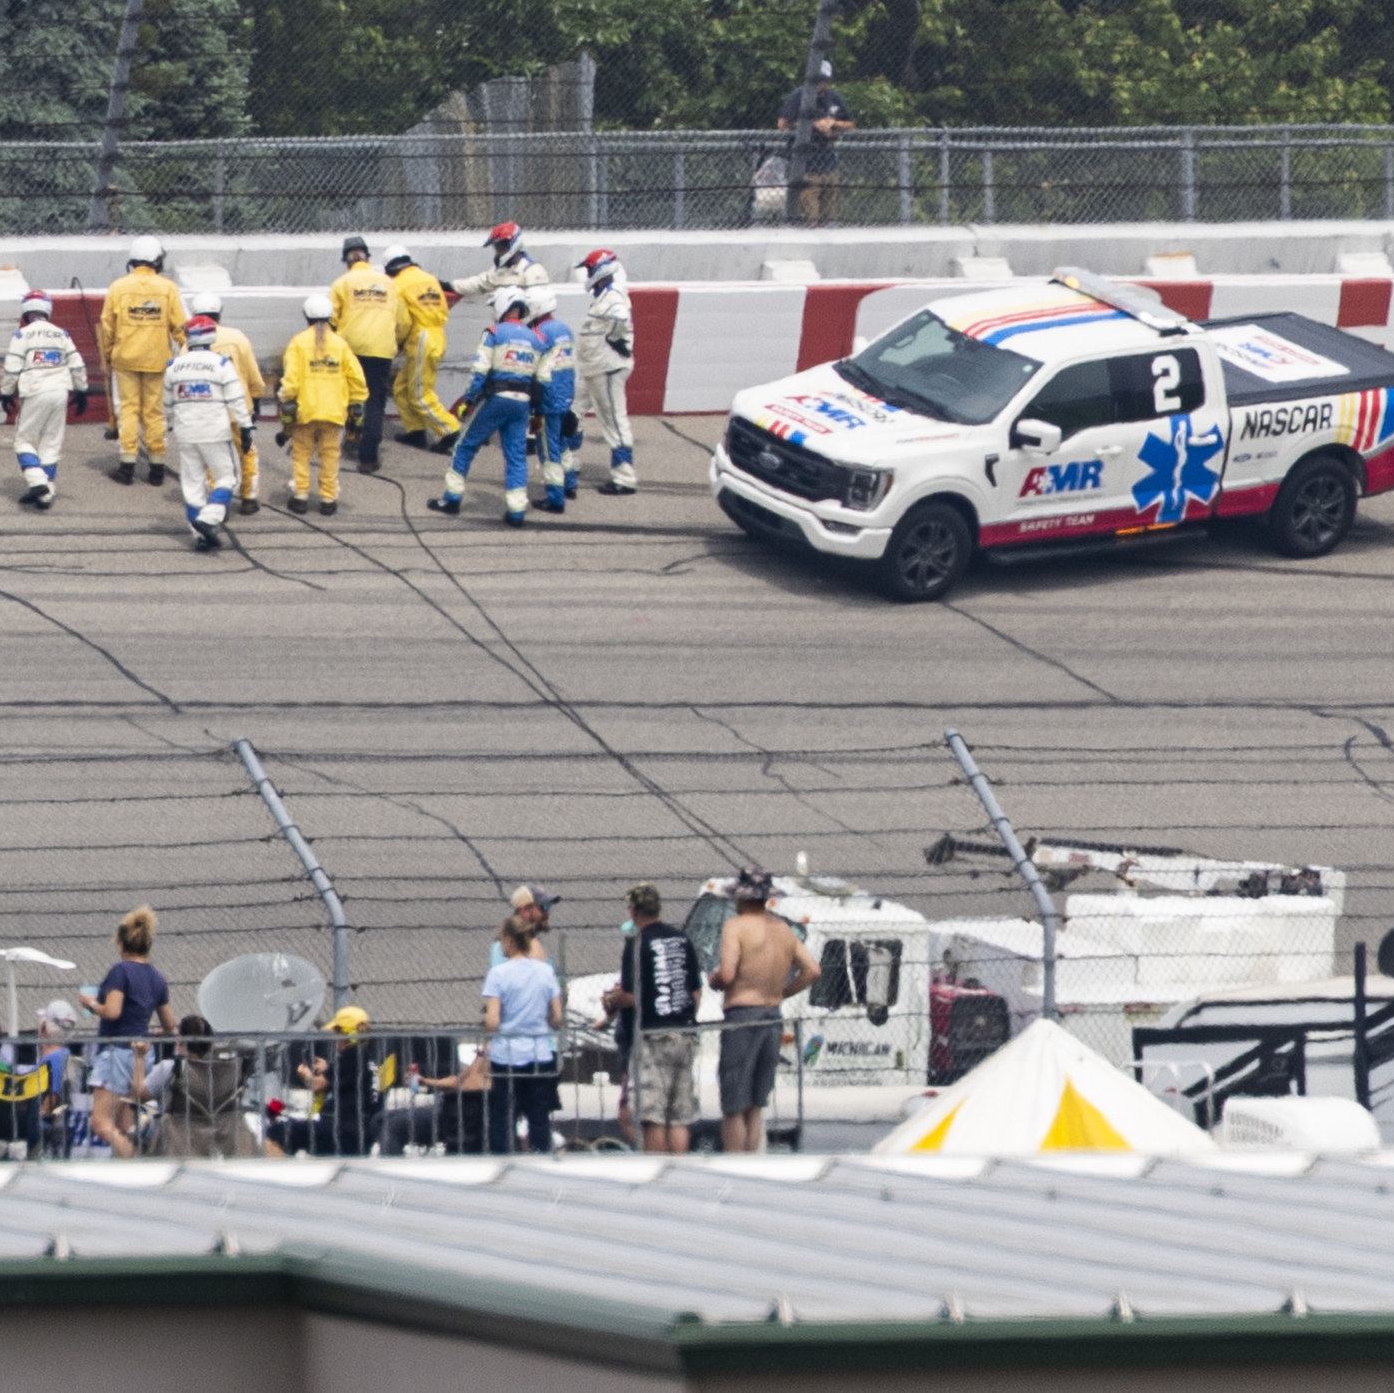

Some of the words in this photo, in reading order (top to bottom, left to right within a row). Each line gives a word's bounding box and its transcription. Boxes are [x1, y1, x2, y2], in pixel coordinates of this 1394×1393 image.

[1151, 354, 1182, 413] 2
[1240, 403, 1333, 441] NASCAR
[1018, 459, 1105, 498] AMR
[1019, 519, 1063, 532] SAFETY
[1065, 514, 1095, 526] TEAM
